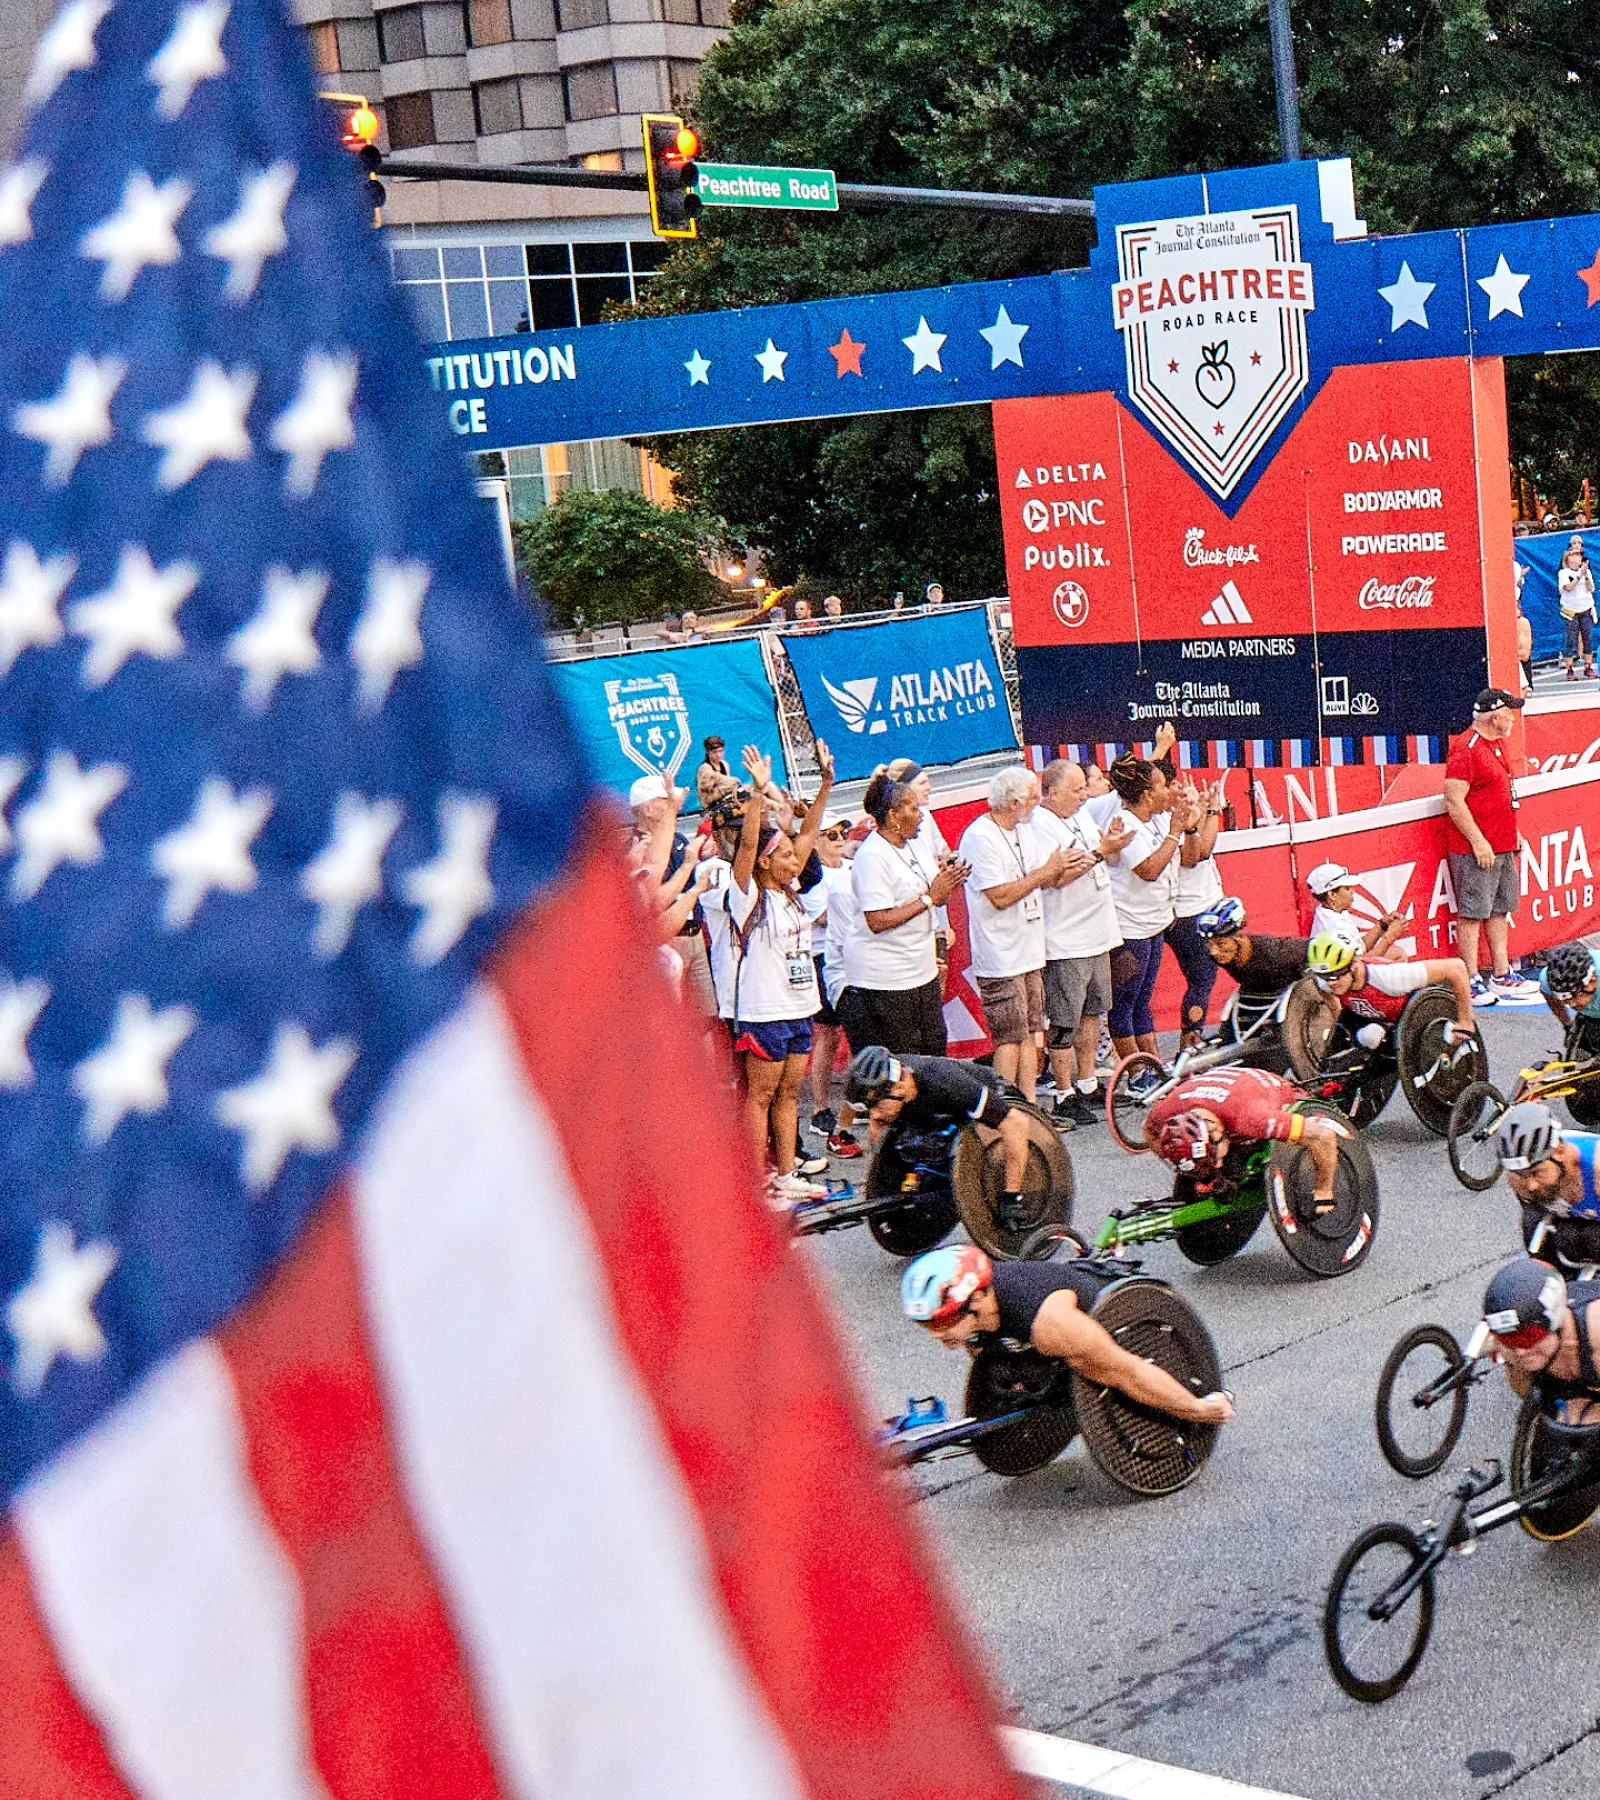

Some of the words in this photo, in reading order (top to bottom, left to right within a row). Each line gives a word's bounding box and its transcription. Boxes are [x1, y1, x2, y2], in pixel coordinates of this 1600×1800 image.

[698, 173, 782, 198] Peachtree
[788, 178, 831, 200] Road
[1175, 223, 1196, 238] The
[1198, 220, 1236, 237] Atlanta
[1154, 231, 1261, 255] Journal-Constitution
[1117, 268, 1307, 320] PEACHTREE
[1162, 313, 1205, 332] ROAD
[1214, 310, 1259, 325] RACE
[1348, 434, 1429, 466] DASANI
[1036, 463, 1107, 485] DELTA
[1051, 499, 1106, 528] PNC
[1343, 488, 1443, 513] BODYARMOR
[1024, 543, 1105, 570] Publix
[1342, 532, 1447, 555] POWERADE
[1358, 576, 1437, 610] Coca-Cola
[1181, 641, 1226, 659] MEDIA
[1229, 638, 1296, 658] PARTNERS
[889, 659, 993, 711] ATLANTA
[1155, 681, 1181, 700] The
[1182, 681, 1230, 699] Atlanta
[608, 697, 686, 721] PEACHTREE
[892, 706, 948, 728] TRACK
[956, 693, 997, 716] CLUB
[1128, 700, 1261, 720] Journal-Constitution
[1427, 825, 1595, 920] ANTA
[1532, 883, 1595, 923] CLUB
